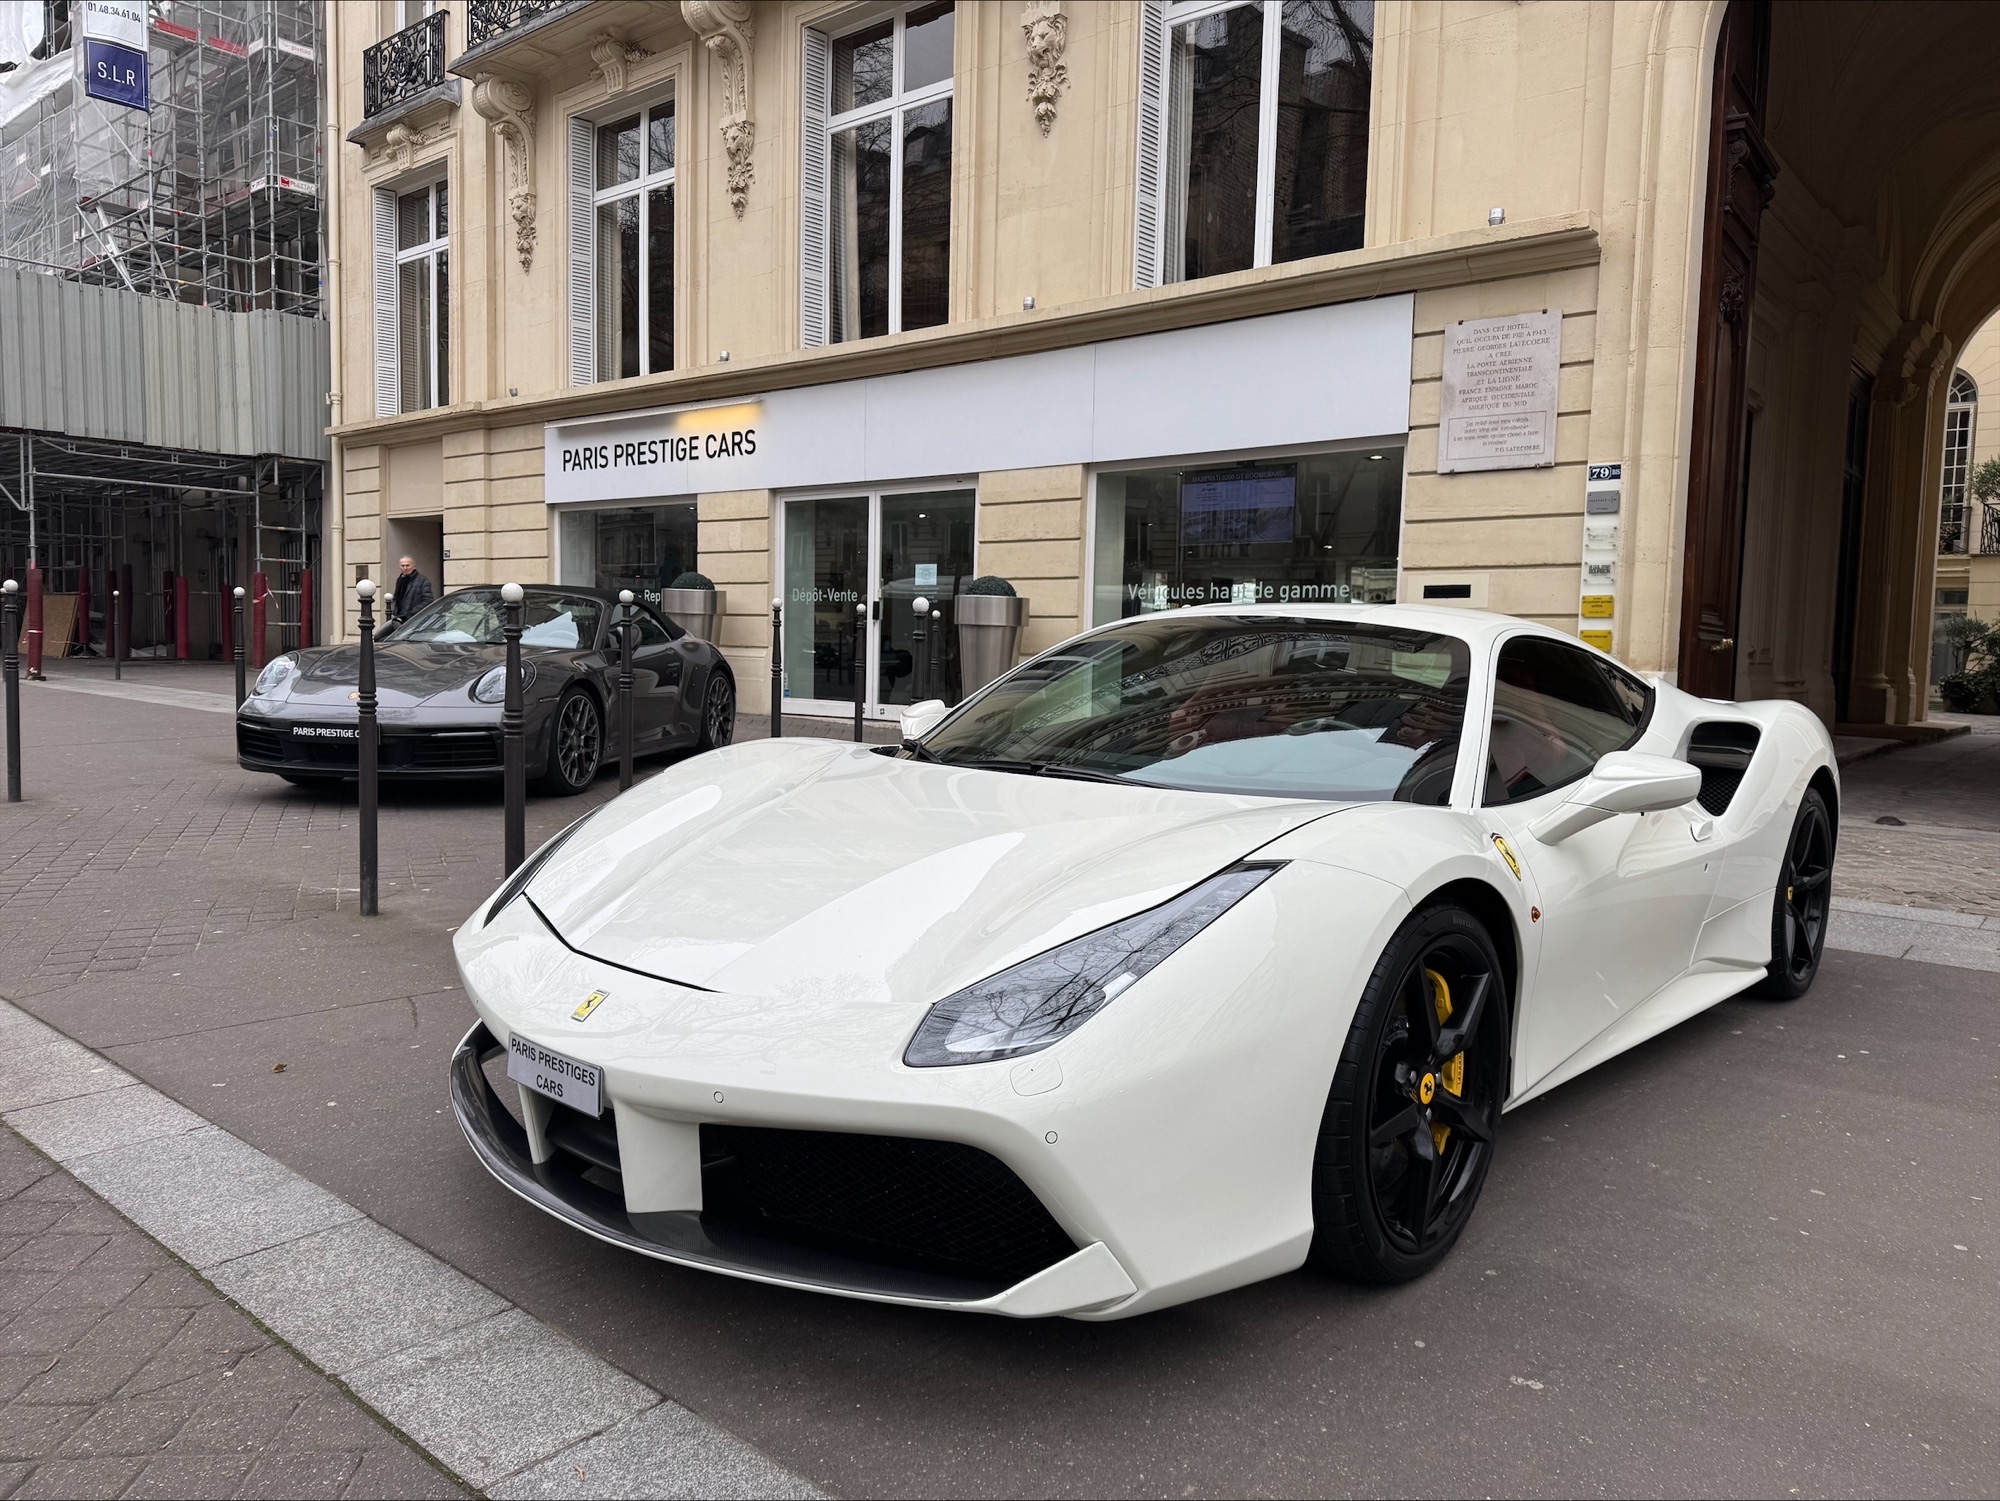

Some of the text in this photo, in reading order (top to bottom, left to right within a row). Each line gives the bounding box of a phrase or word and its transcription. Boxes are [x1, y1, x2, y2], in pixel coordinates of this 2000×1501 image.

[88, 2, 140, 22] 01.48.34.61.04
[98, 62, 135, 86] S.L.R
[1507, 323, 1529, 331] HOTEL
[1474, 335, 1500, 343] OCCUPA
[1453, 345, 1474, 354] PIERRE
[1478, 343, 1507, 352] GEORGES
[1467, 365, 1533, 378] TRANSCONTINENTALE
[1498, 375, 1521, 384] LIGNE
[1485, 385, 1512, 393] ESPAGNE
[1461, 391, 1536, 404] AFRIQUE OCCIDENTALE
[562, 429, 756, 472] PARIS PRESTIGE CARS
[1592, 468, 1609, 479] 79
[644, 590, 660, 605] Rep
[792, 587, 858, 605] Dépôt-Vente
[1128, 582, 1204, 600] Véhicules
[1255, 581, 1274, 598] de
[1280, 584, 1350, 603] gamme
[293, 727, 315, 736] PARIS
[316, 728, 354, 738] PRESTIGE
[511, 1038, 595, 1087] PARIS PRESTIGES
[536, 1074, 563, 1098] CARS
